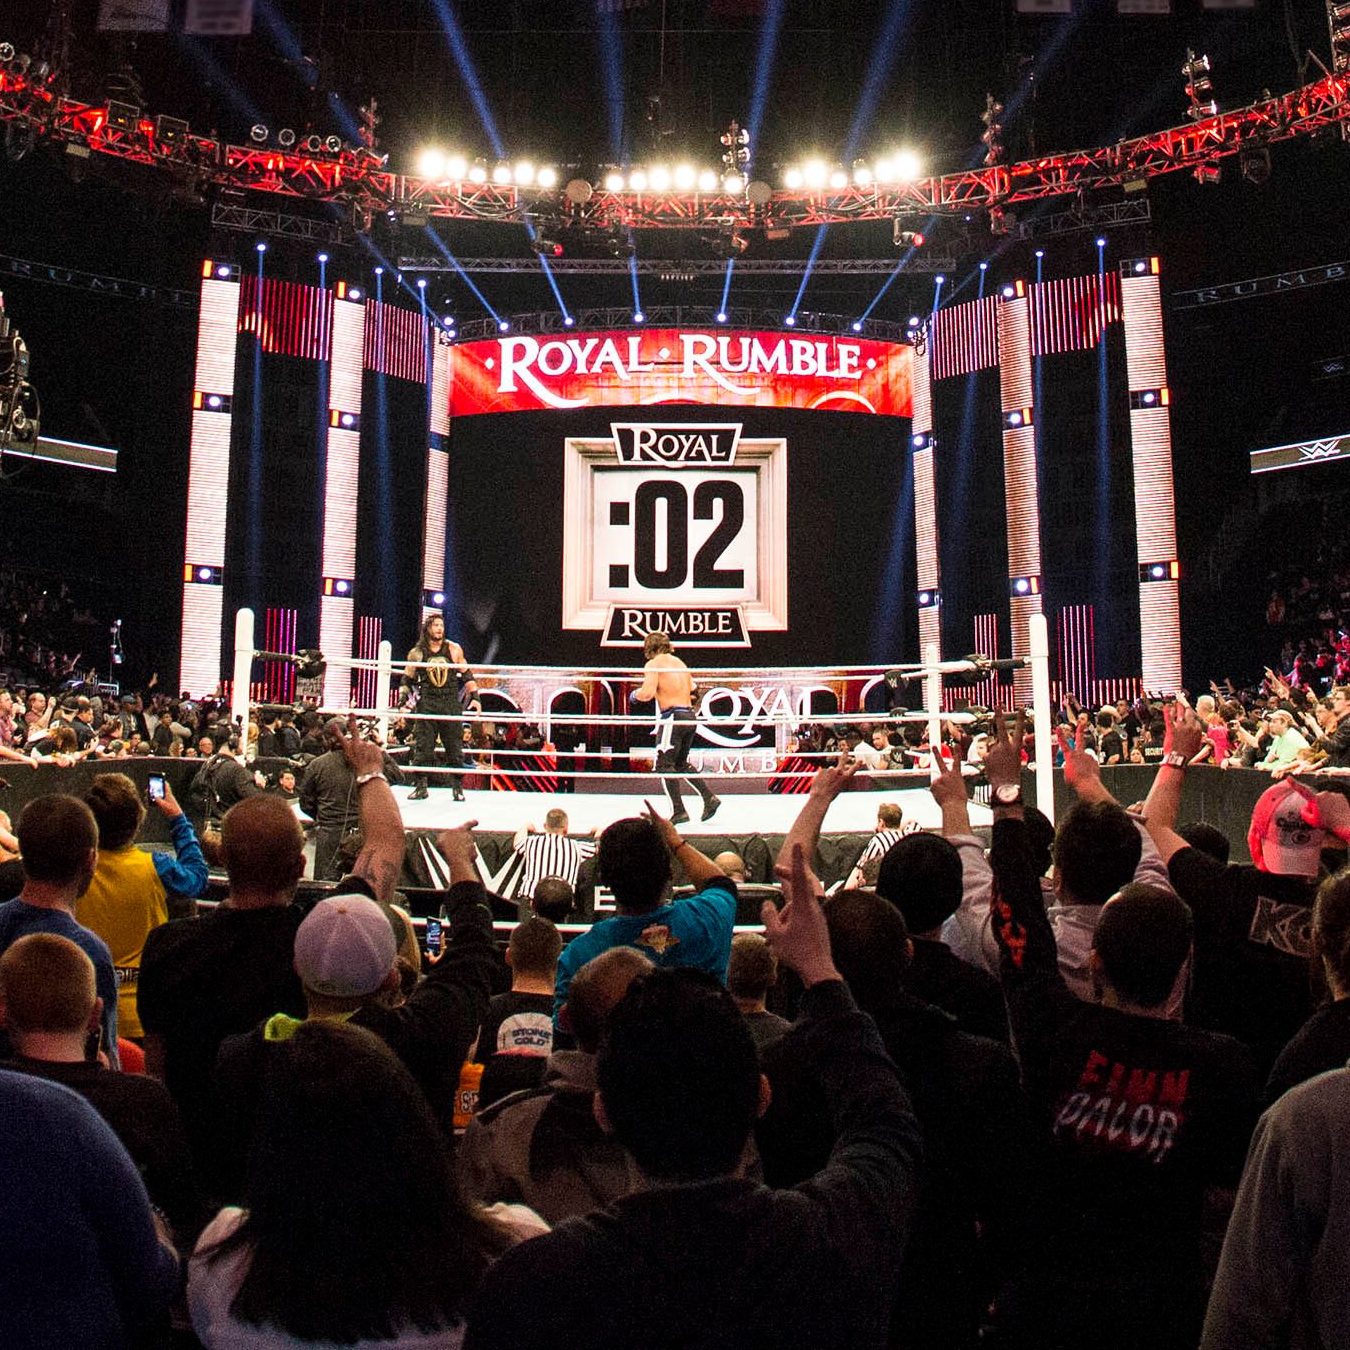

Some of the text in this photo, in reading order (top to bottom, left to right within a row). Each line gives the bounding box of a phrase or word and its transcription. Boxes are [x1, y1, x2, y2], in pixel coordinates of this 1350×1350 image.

[497, 333, 863, 408] ROYAL RUMBLE
[630, 427, 726, 468] ROYAL
[608, 479, 745, 589] :02
[620, 609, 733, 638] RUMBLE
